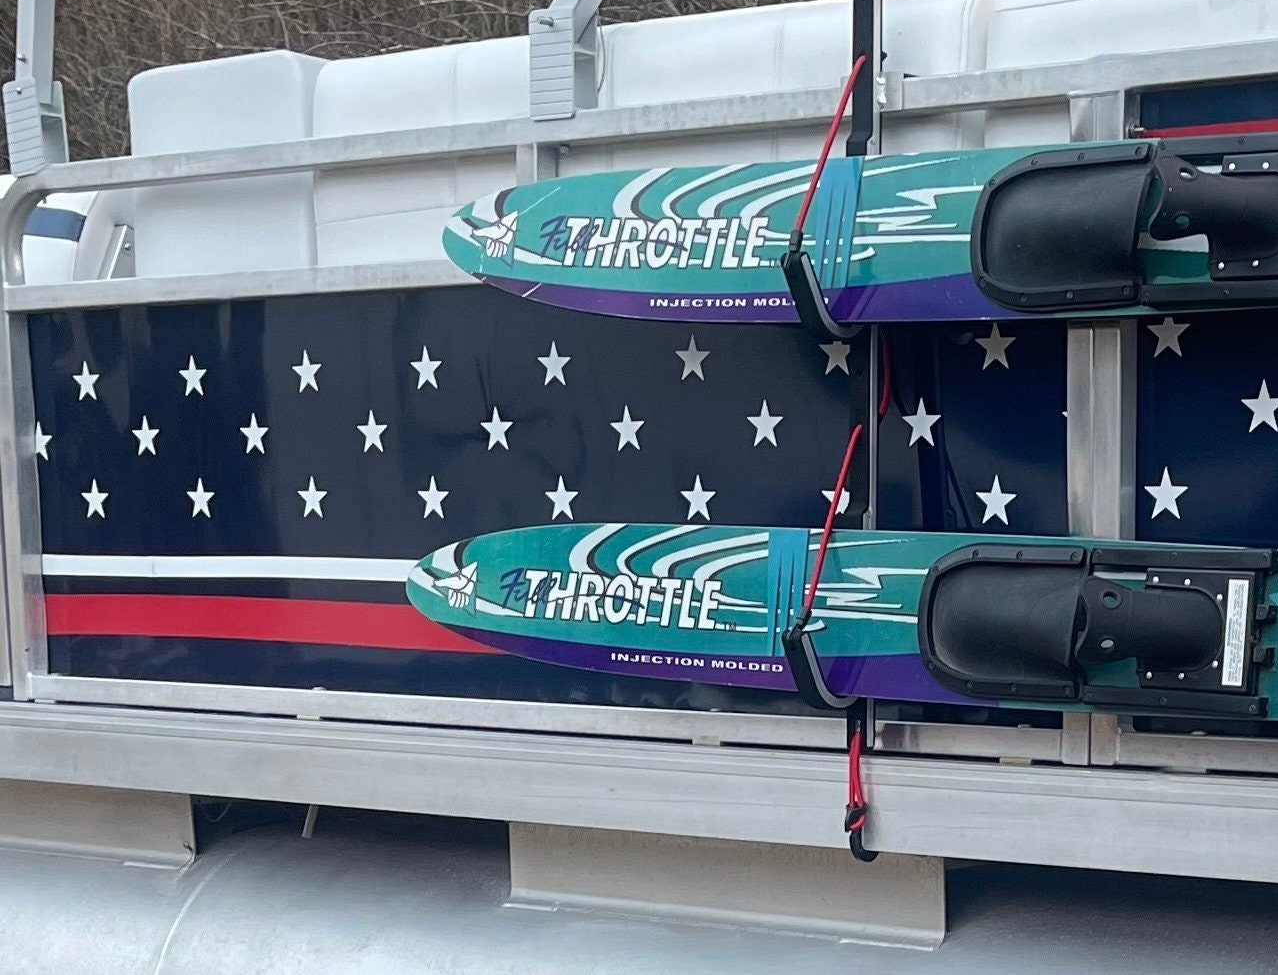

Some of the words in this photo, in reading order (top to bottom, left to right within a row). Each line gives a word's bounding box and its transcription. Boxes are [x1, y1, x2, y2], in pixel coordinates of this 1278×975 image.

[562, 216, 769, 269] THROTTLE
[649, 298, 747, 308] INJECTION
[523, 569, 722, 631] THROTTLE
[610, 652, 705, 667] INJECTION
[711, 660, 784, 673] MOLDED
